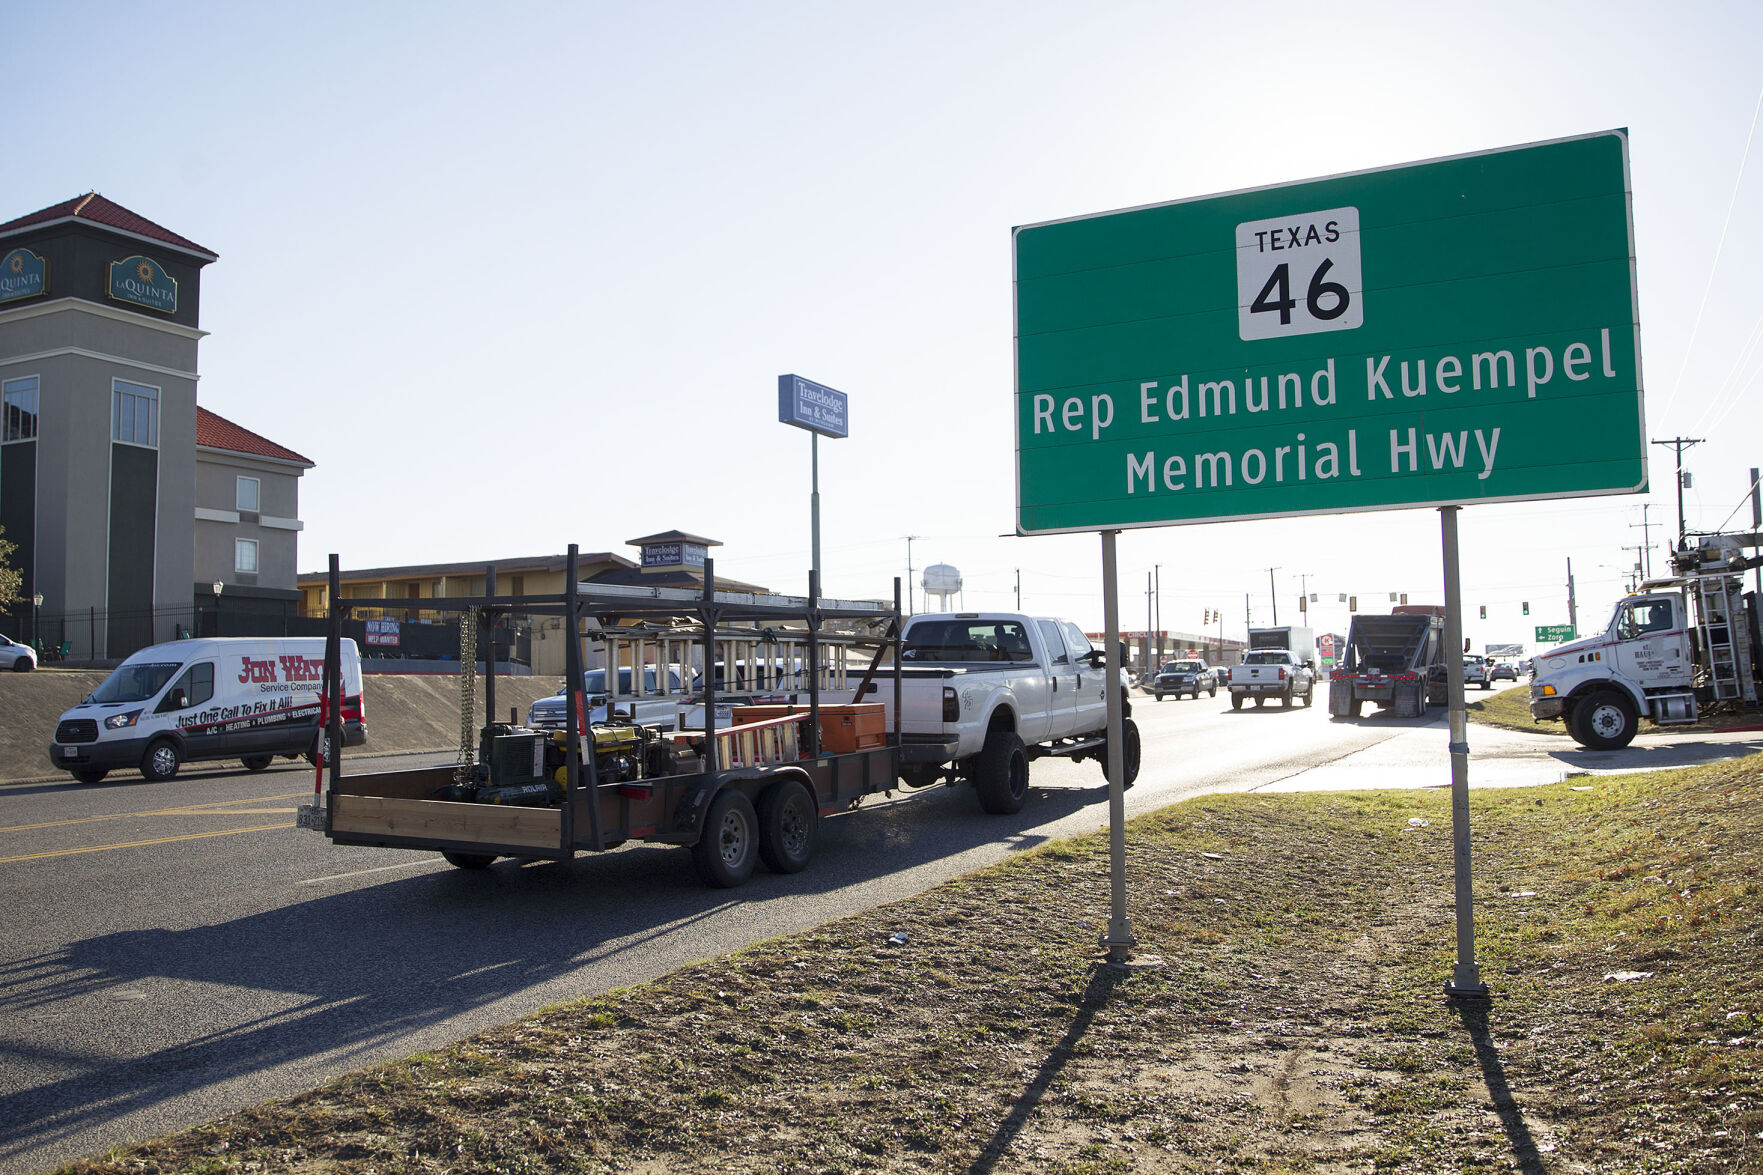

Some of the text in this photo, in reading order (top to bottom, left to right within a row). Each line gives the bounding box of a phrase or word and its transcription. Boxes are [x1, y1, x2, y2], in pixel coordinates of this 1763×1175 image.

[1254, 220, 1341, 253] TEXAS
[1, 273, 40, 291] QUINTA
[125, 279, 174, 303] QUINTA
[1249, 257, 1352, 326] 46
[798, 382, 843, 413] Travelodge
[1033, 328, 1616, 440] Rep Edmund Kuempel
[800, 401, 812, 416] Inn
[822, 408, 843, 425] Suites
[1126, 427, 1501, 494] Memorial Hwy
[1547, 626, 1572, 634] Seguin
[238, 657, 277, 684] JON
[261, 682, 324, 693] Service Compan
[175, 713, 198, 728] Just
[200, 711, 219, 724] One
[220, 705, 239, 720] Call
[241, 703, 252, 716] To
[253, 701, 268, 713] Fix
[269, 698, 277, 711] It
[206, 726, 218, 735] A/C
[225, 720, 251, 731] HEATING
[257, 712, 287, 725] PLUMBING
